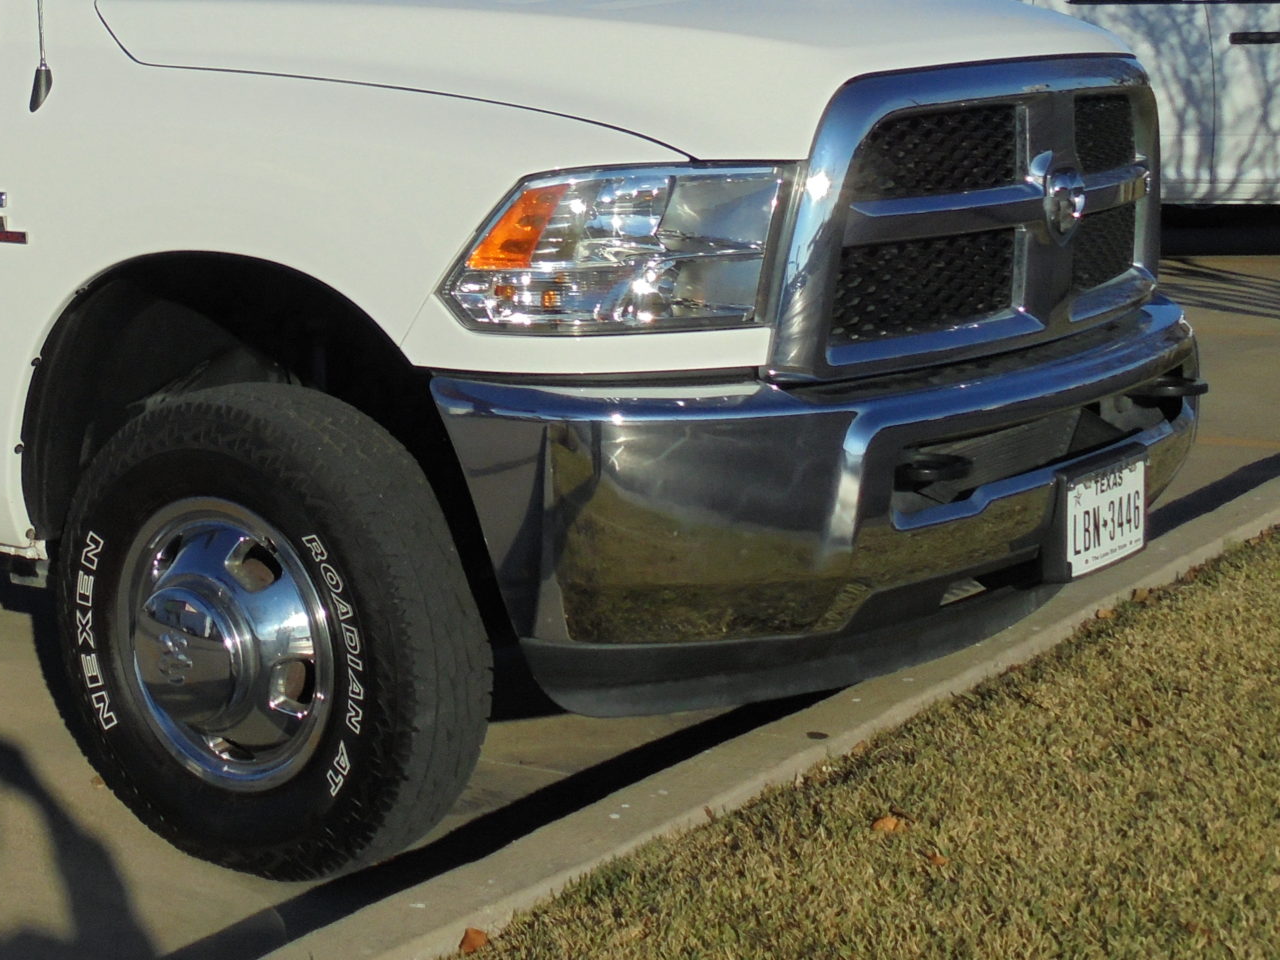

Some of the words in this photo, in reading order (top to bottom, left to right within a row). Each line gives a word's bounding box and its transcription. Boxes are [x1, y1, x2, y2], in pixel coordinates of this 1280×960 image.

[1094, 472, 1124, 496] TEXAS
[1073, 506, 1101, 556] LBN
[1108, 490, 1141, 541] 3446
[74, 530, 117, 731] NEXEN
[302, 534, 367, 734] ROADIAN
[325, 740, 352, 797] AT
